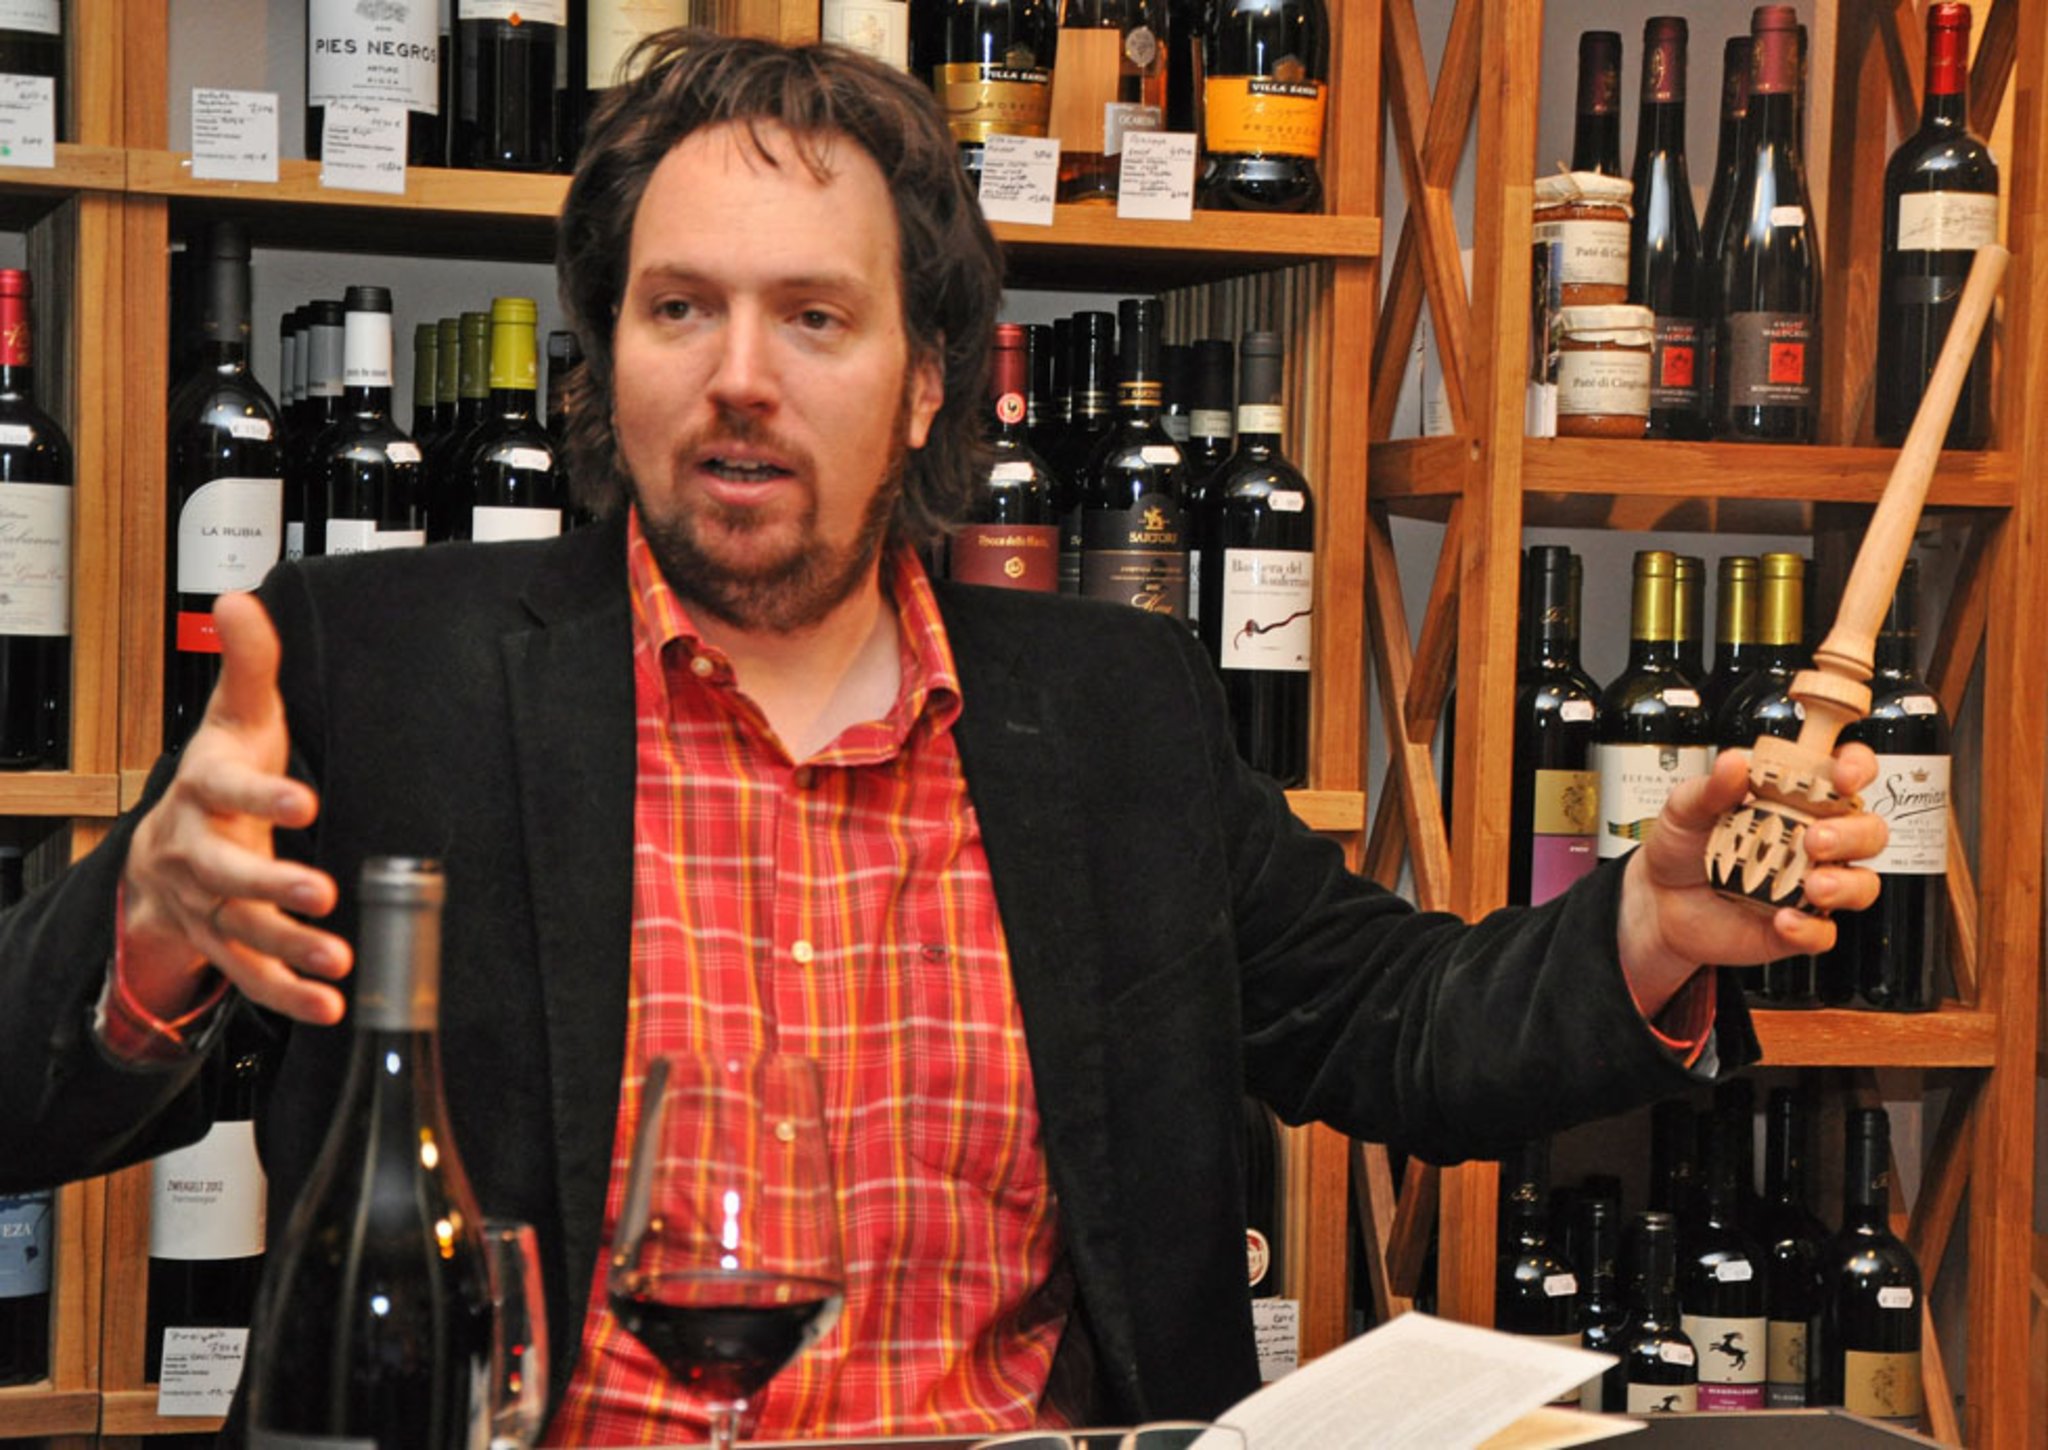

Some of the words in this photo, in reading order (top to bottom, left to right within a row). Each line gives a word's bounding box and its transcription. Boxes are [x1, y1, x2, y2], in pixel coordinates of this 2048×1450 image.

[314, 38, 357, 54] PIES
[367, 41, 436, 63] NEGROS
[1252, 83, 1287, 93] VILLA
[202, 527, 218, 537] LA
[223, 527, 262, 537] RUBIA
